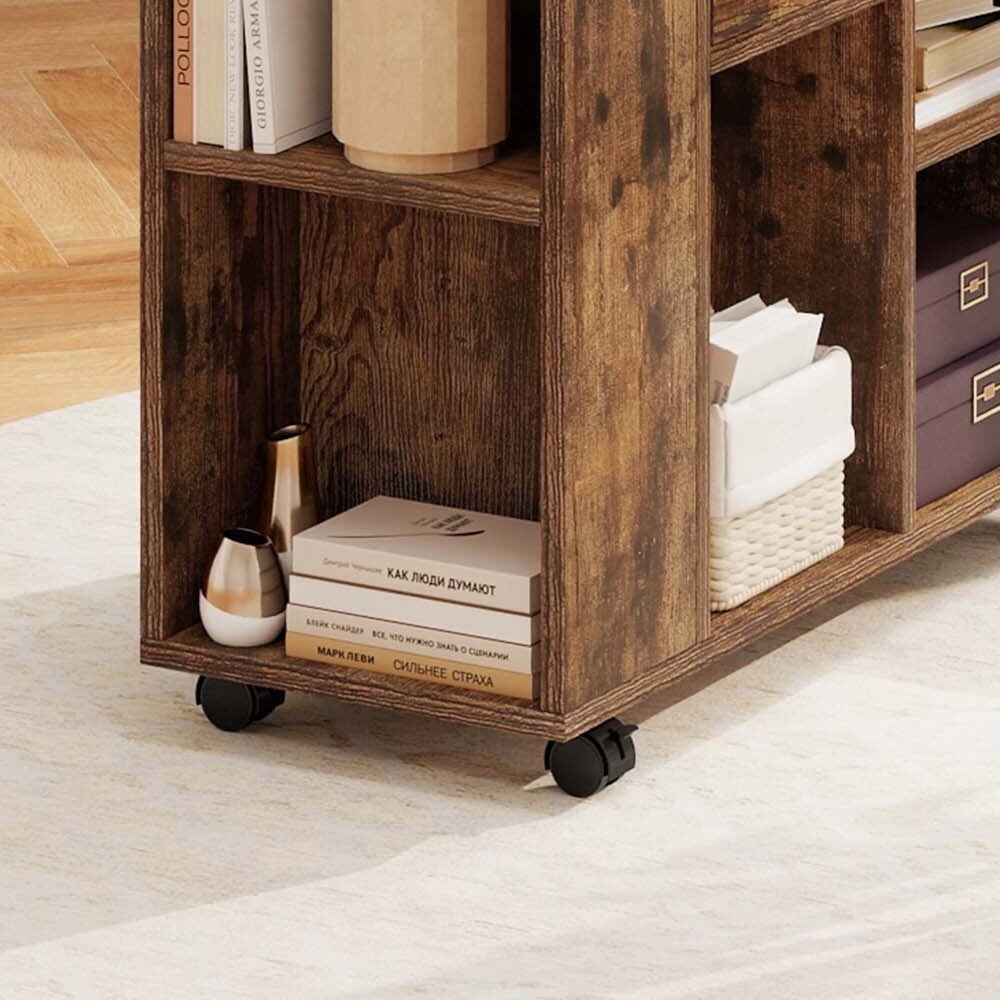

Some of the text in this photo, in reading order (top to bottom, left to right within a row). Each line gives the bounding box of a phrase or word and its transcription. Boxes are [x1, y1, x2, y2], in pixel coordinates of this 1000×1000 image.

[252, 56, 267, 129] GIORGIO
[387, 567, 496, 596] КАК ЛЮДИ ДУМАЮТ
[317, 646, 375, 665] МАРК ЛЕВИ
[389, 633, 404, 643] ЧТО
[405, 636, 435, 648] НУЖНО
[436, 641, 459, 653] ЗНАТЬ
[460, 645, 468, 655] О
[393, 658, 495, 688] СИЛЬНЕЕ СТРАХА
